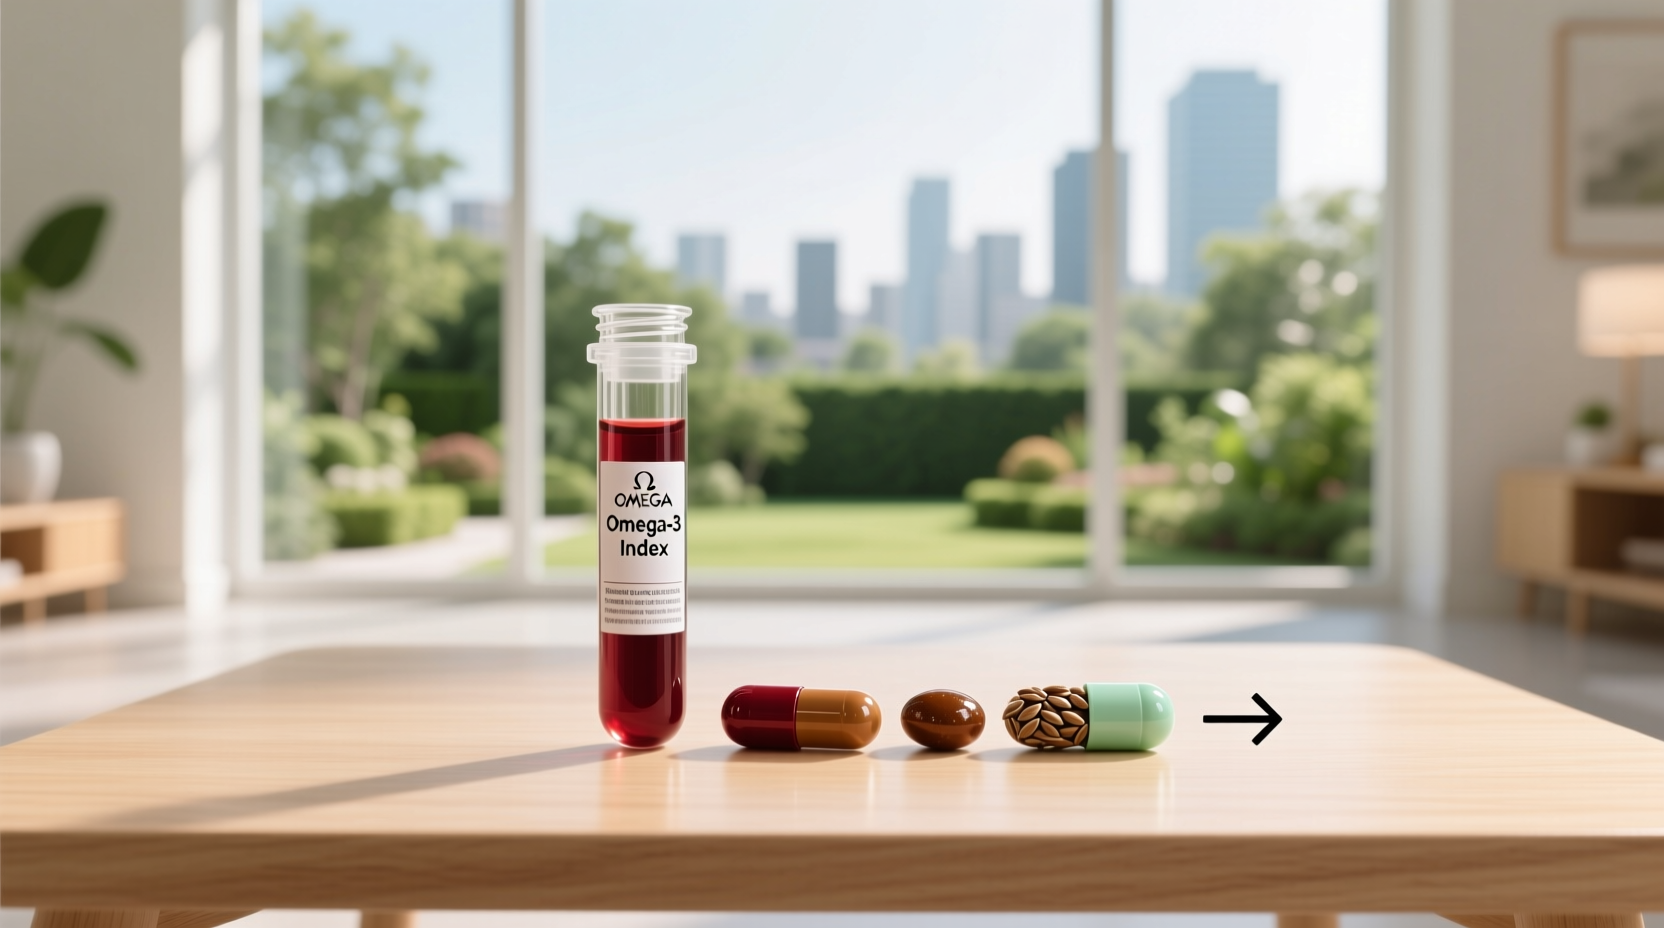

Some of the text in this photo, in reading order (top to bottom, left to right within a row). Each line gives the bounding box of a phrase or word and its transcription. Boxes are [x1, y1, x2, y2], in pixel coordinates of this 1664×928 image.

[614, 492, 673, 508] OMEGA
[606, 514, 681, 537] Omega-3
[620, 539, 669, 557] Index
